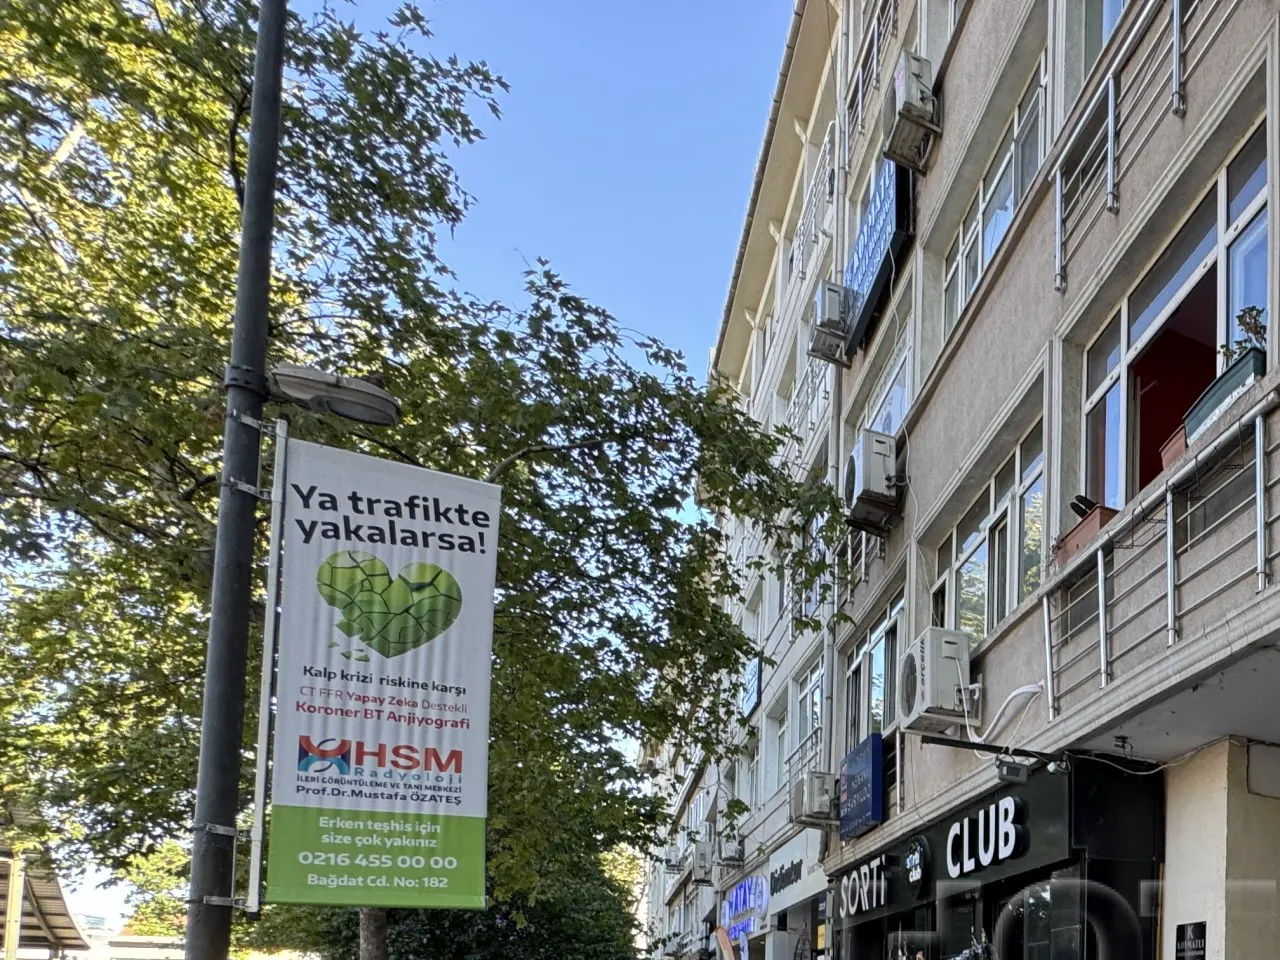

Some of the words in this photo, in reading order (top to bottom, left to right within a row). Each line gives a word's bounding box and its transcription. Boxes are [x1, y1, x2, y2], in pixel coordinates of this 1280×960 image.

[291, 483, 338, 512] Ya
[347, 491, 490, 528] trafikte
[295, 515, 487, 555] yakalarsa!
[303, 665, 337, 682] Kalp
[340, 669, 373, 684] krizi
[379, 675, 428, 691] riskine
[432, 680, 466, 698] karşı
[299, 685, 316, 697] CT
[319, 687, 343, 700] FFR
[346, 691, 386, 707] Yapay
[388, 696, 418, 708] Zeka
[421, 699, 468, 714] Destekli
[296, 701, 360, 719] Koroner
[363, 709, 384, 721] BT
[386, 711, 470, 730] Anjiyografi
[354, 741, 463, 774] HSM
[296, 774, 320, 783] İLERİ
[321, 776, 388, 789] GÖRÜNTÜLEME
[389, 782, 401, 790] VE
[403, 782, 423, 791] TANI
[425, 784, 462, 794] MERKEZİ
[354, 767, 463, 784] Radyoloji
[295, 785, 408, 802] Prof.Dr.Mustafa
[410, 790, 462, 806] ÖZATEŞ
[319, 816, 365, 831] Erken
[367, 819, 413, 834] teşhis
[415, 821, 441, 835] için
[321, 833, 353, 845] size
[355, 834, 382, 848] çok
[385, 836, 438, 849] yakınız
[946, 795, 1016, 879] CLUB
[298, 851, 351, 867] 0216
[354, 853, 392, 868] 455
[397, 855, 425, 869] 00
[429, 855, 458, 869] 00
[307, 873, 364, 888] Bağdat
[366, 875, 391, 888] Cd.
[393, 876, 419, 888] No:
[422, 876, 448, 888] 182
[1187, 924, 1194, 939] K
